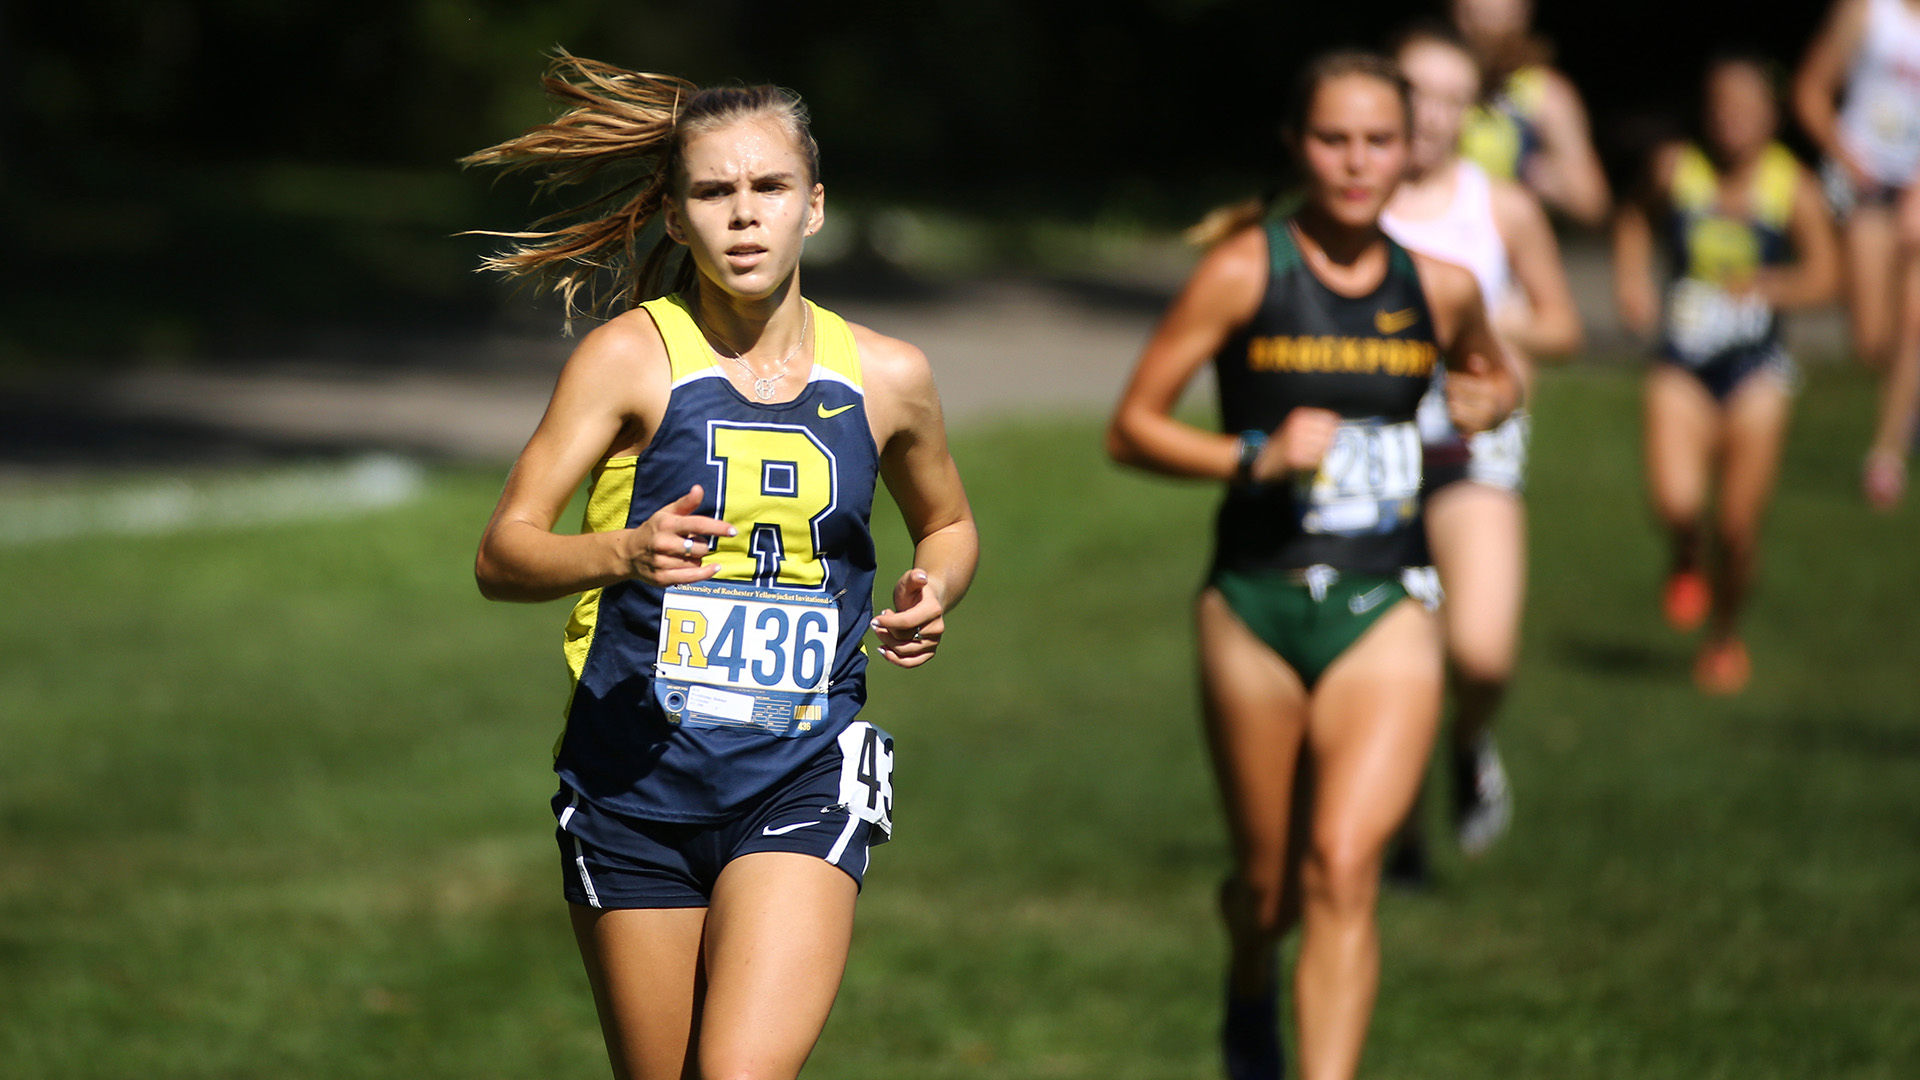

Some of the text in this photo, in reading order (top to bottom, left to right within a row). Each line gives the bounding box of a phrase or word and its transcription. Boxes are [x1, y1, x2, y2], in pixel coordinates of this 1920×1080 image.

[700, 420, 838, 592] R
[674, 584, 712, 594] University
[721, 588, 754, 597] Rochester
[755, 591, 795, 600] Yellowjacket
[796, 594, 829, 604] Invitational
[707, 605, 828, 689] 436
